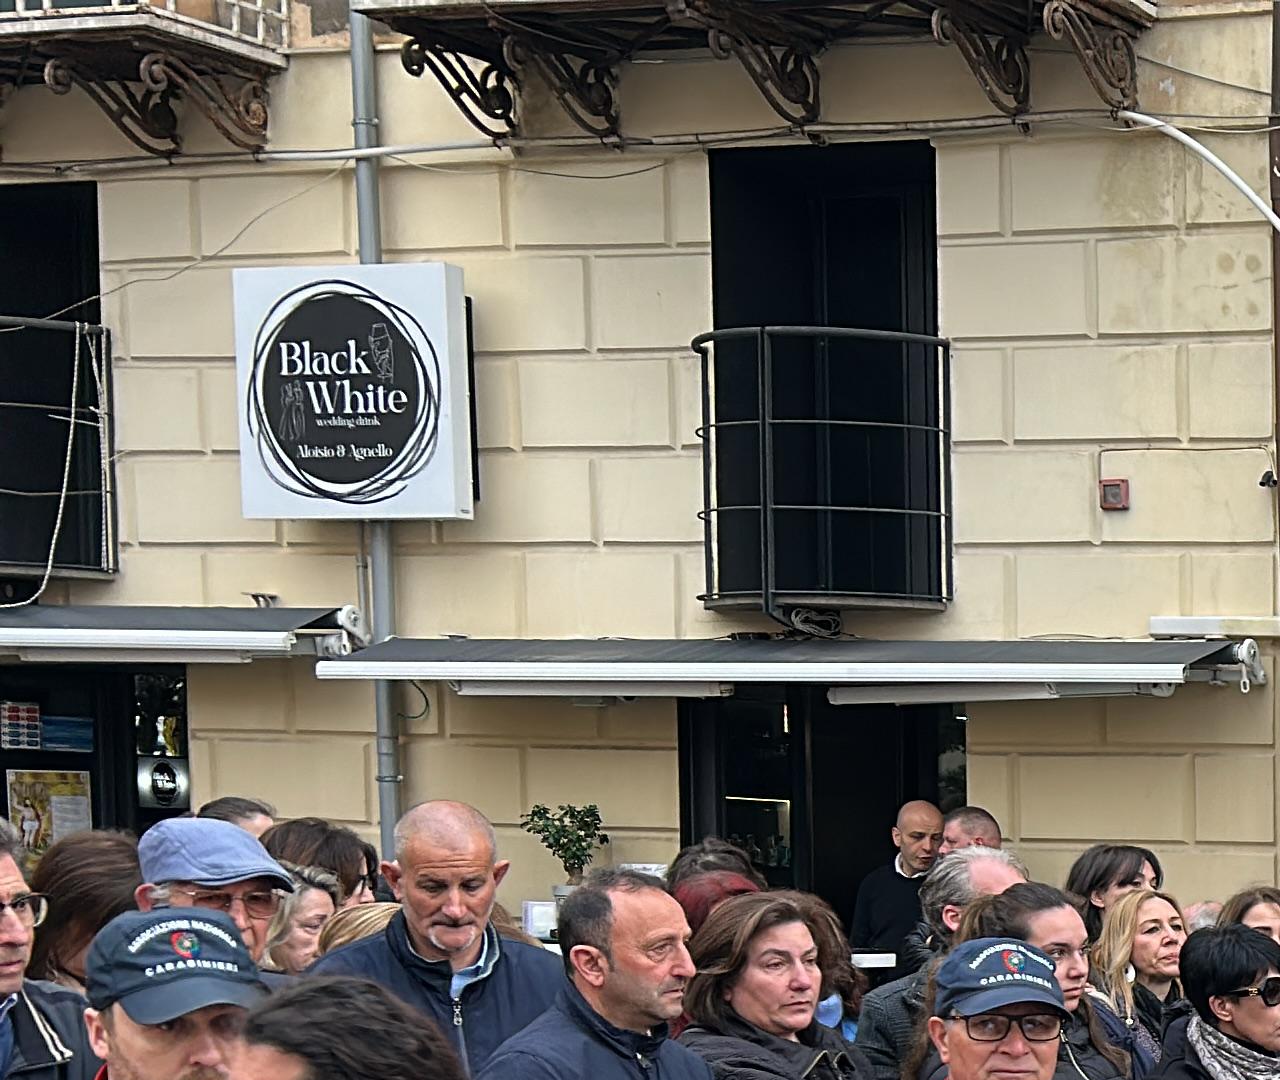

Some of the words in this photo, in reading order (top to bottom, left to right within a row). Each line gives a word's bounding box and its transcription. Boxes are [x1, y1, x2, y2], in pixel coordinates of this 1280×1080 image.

[280, 340, 371, 376] Black
[306, 381, 408, 415] White
[316, 416, 355, 428] wedding
[297, 445, 335, 459] Aloisio
[348, 443, 393, 461] Agnello
[145, 958, 239, 977] CARABINIERI
[979, 973, 1053, 989] CARABINIERI
